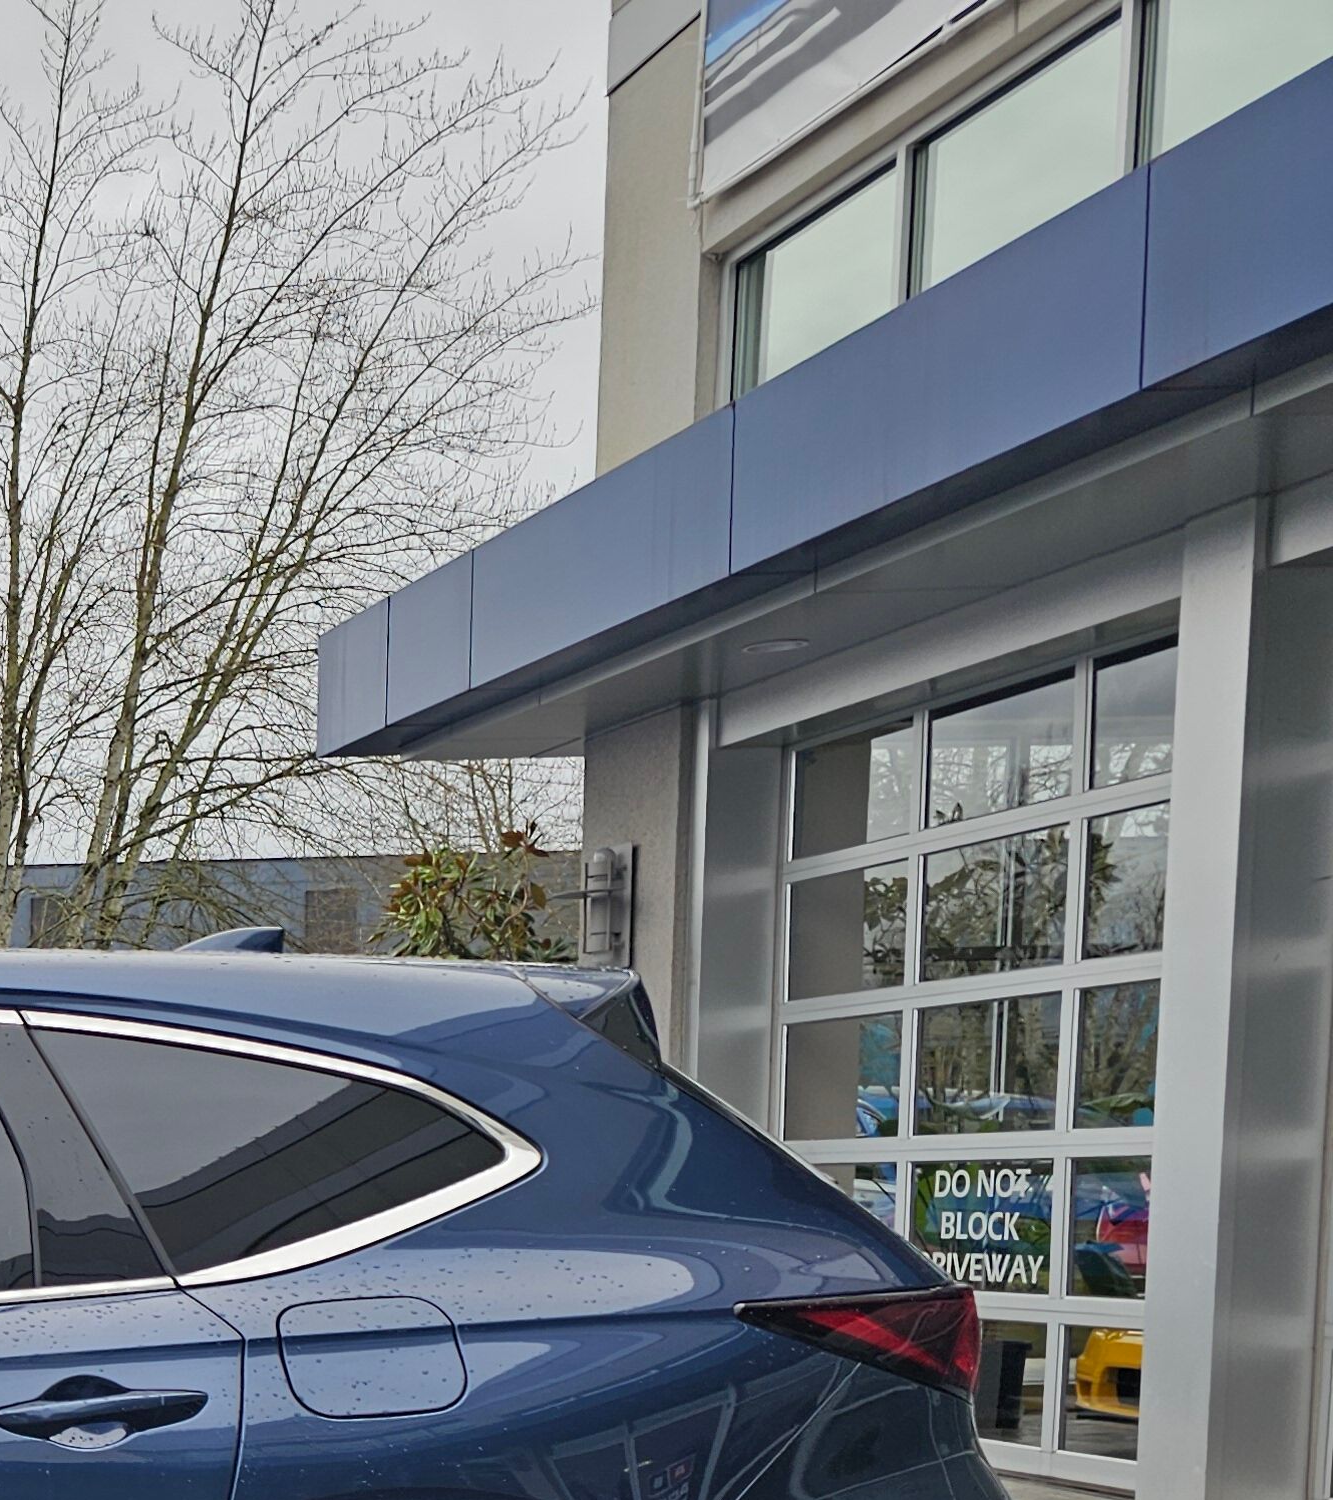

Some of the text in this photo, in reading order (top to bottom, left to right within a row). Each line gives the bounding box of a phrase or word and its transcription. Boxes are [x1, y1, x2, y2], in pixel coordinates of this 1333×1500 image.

[933, 1168, 1032, 1198] DO NOT
[940, 1211, 1020, 1241] BLOCK
[923, 1251, 1044, 1284] RIVEWAY
